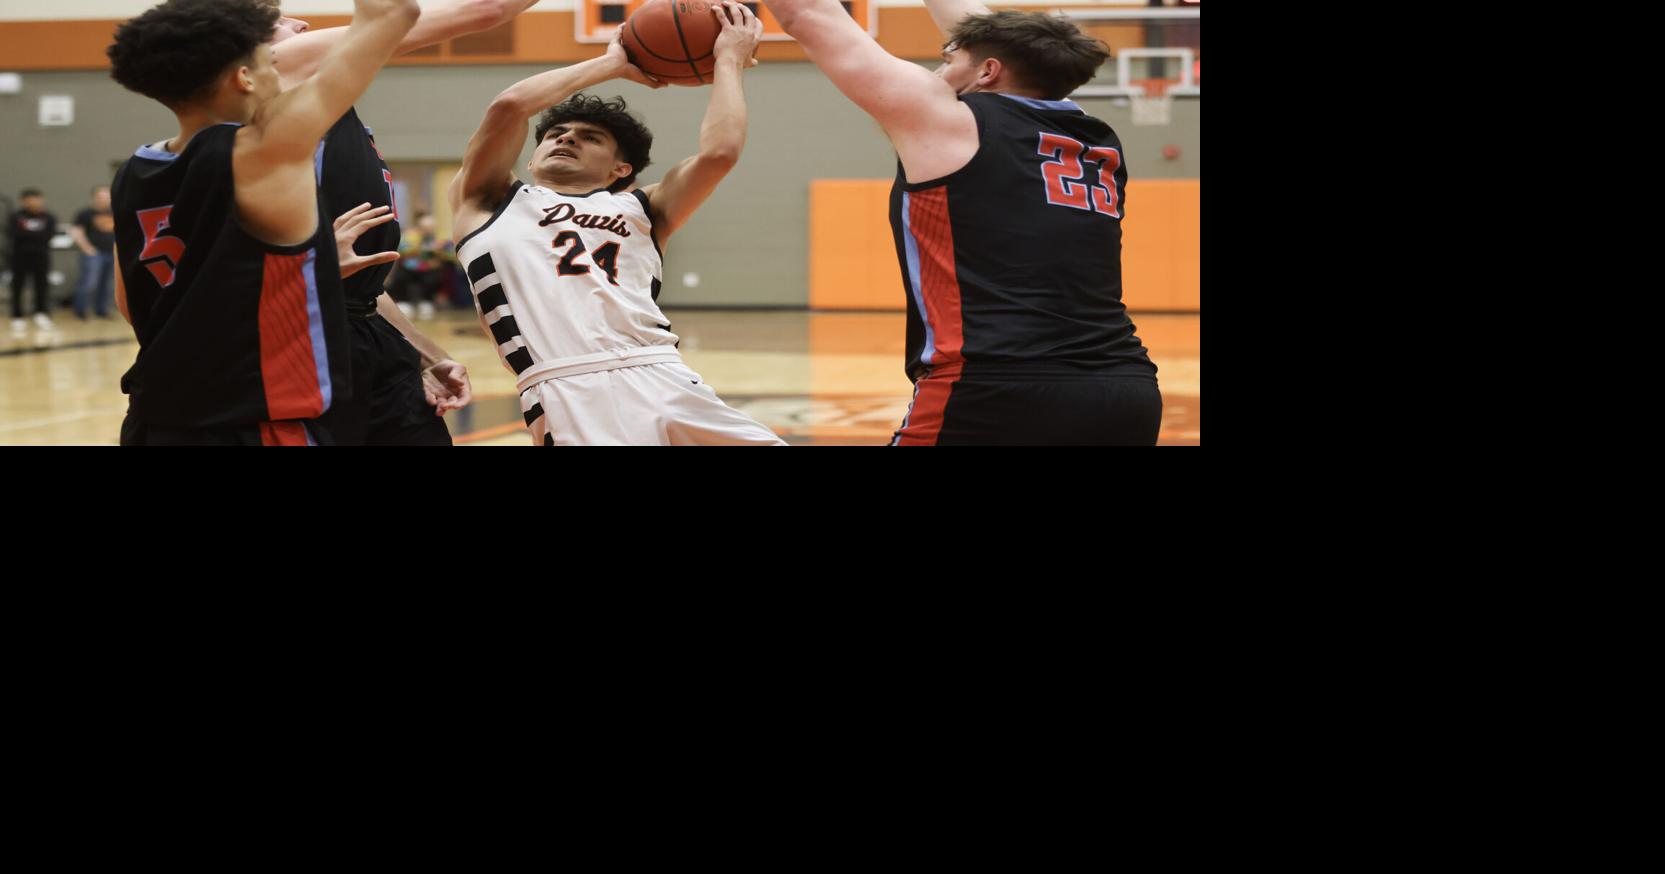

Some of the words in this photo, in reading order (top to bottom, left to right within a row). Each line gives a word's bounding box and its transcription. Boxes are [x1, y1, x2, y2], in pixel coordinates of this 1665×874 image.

[1037, 131, 1120, 219] 23
[136, 204, 186, 288] 5
[538, 203, 631, 238] Davis
[552, 230, 621, 287] 24
